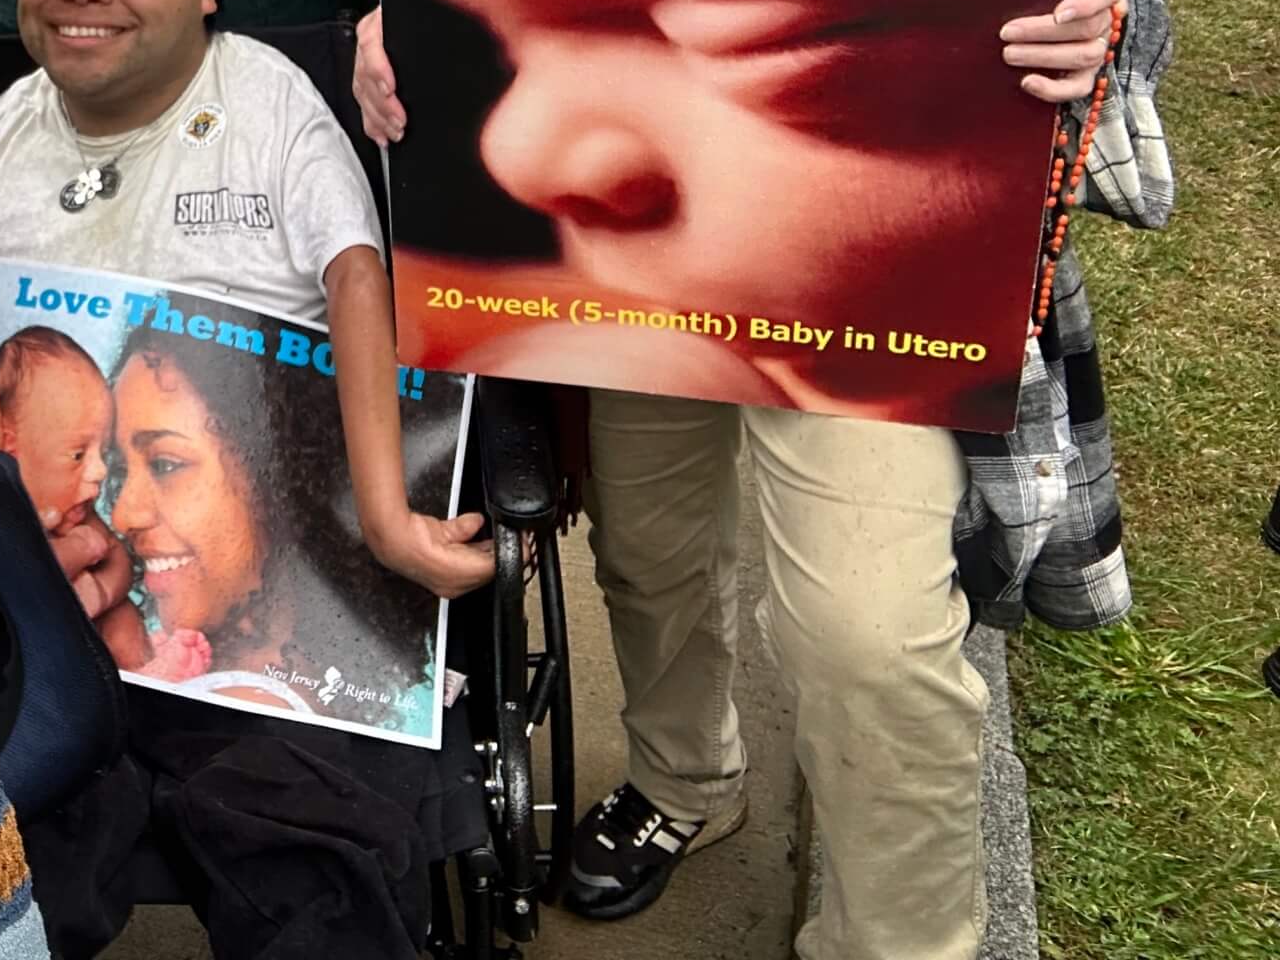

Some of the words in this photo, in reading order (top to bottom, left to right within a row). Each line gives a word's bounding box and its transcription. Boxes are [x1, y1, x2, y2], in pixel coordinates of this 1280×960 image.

[15, 277, 112, 318] Love
[123, 291, 266, 356] Them
[275, 328, 426, 400] BO!
[426, 287, 560, 319] 20-week
[568, 298, 738, 341] (5-month)
[749, 317, 834, 351] Baby
[844, 326, 876, 351] in
[888, 331, 987, 362] Utero
[263, 664, 289, 681] New
[289, 671, 321, 691] Jersey
[344, 683, 377, 702] Right
[379, 692, 392, 704] to
